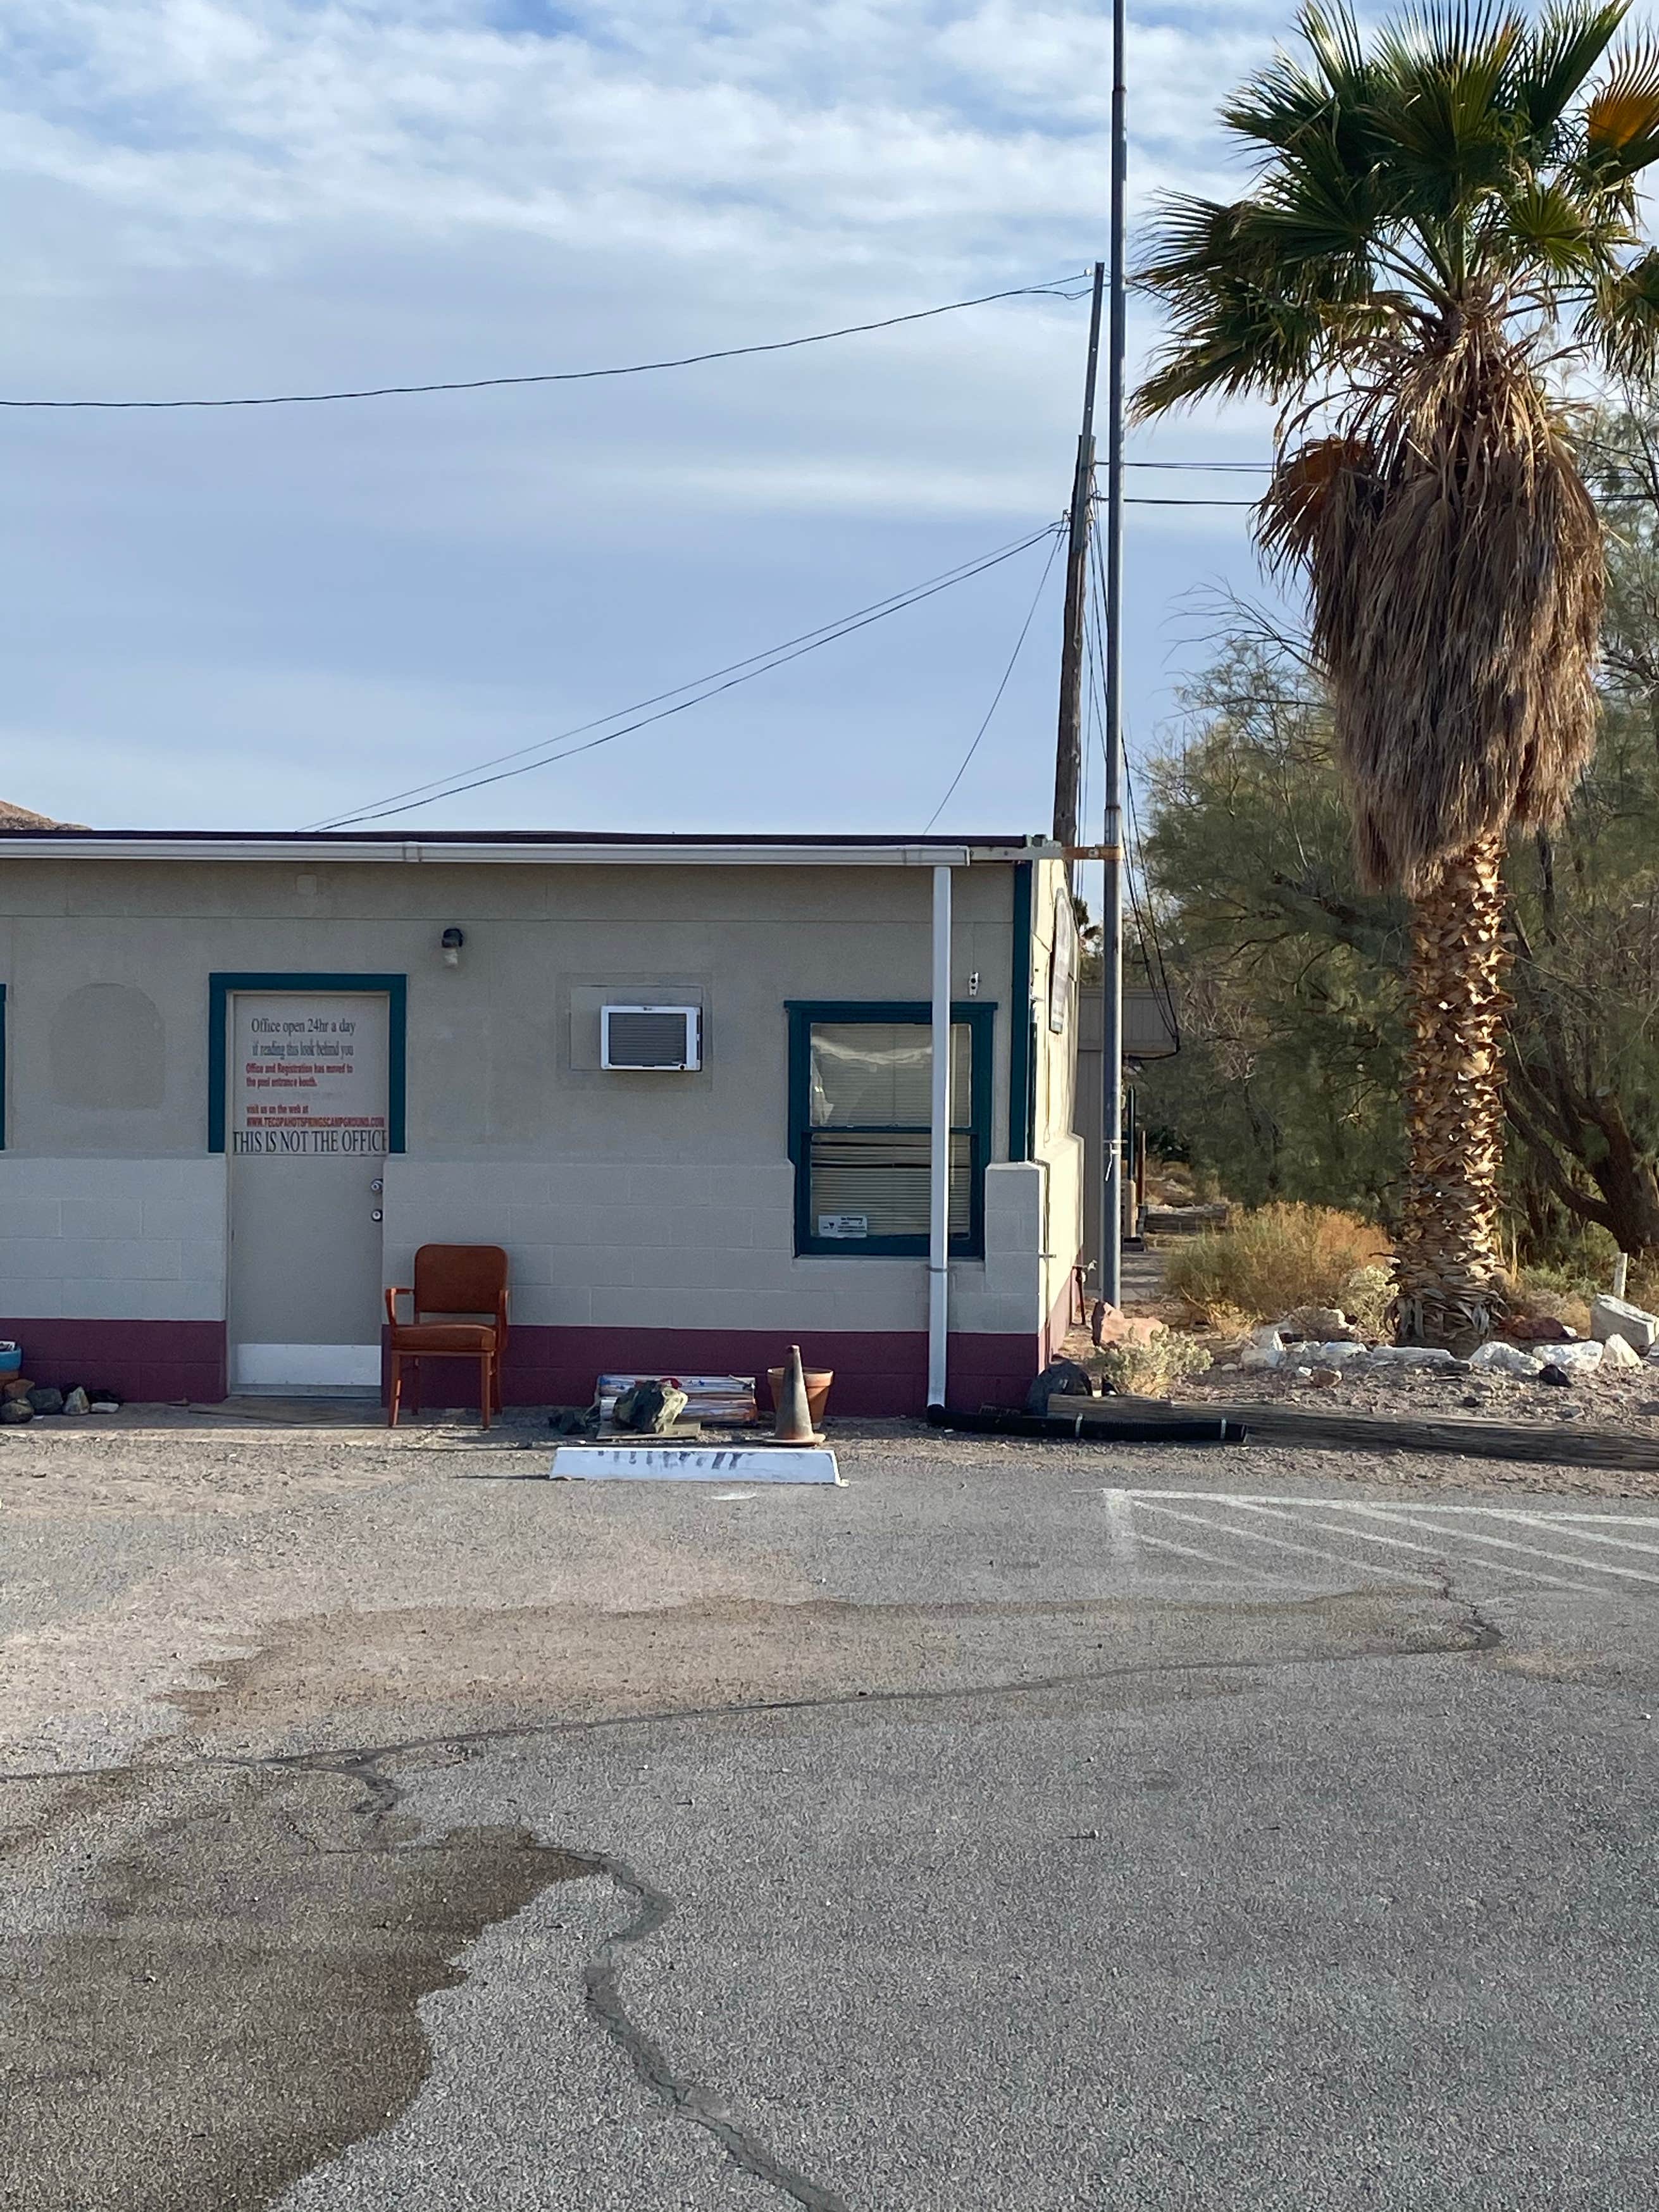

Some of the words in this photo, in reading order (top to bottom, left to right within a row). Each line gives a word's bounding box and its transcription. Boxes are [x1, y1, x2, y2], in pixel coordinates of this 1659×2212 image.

[251, 1018, 281, 1032] Office
[283, 1022, 305, 1036] open
[308, 1018, 329, 1033] 24hr
[331, 1022, 337, 1033] a
[339, 1018, 356, 1036] day
[252, 1041, 259, 1055] if
[260, 1040, 285, 1060] reading
[287, 1041, 299, 1055] this
[300, 1039, 315, 1056] look
[316, 1040, 340, 1056] behind
[341, 1045, 354, 1059] you
[246, 1063, 264, 1073] Office
[265, 1063, 275, 1073] and
[277, 1063, 313, 1076] Registration
[314, 1063, 325, 1073] has
[326, 1063, 345, 1073] moved
[347, 1063, 354, 1073] to
[246, 1077, 256, 1086] the
[258, 1077, 270, 1088] pool
[271, 1078, 297, 1087] entrance
[246, 1104, 259, 1114] visit
[276, 1104, 287, 1114] the
[289, 1104, 301, 1114] web
[302, 1105, 309, 1114] at
[233, 1131, 262, 1152] THIS
[266, 1131, 276, 1152] IS
[280, 1130, 309, 1152] NOT
[311, 1130, 339, 1152] THE
